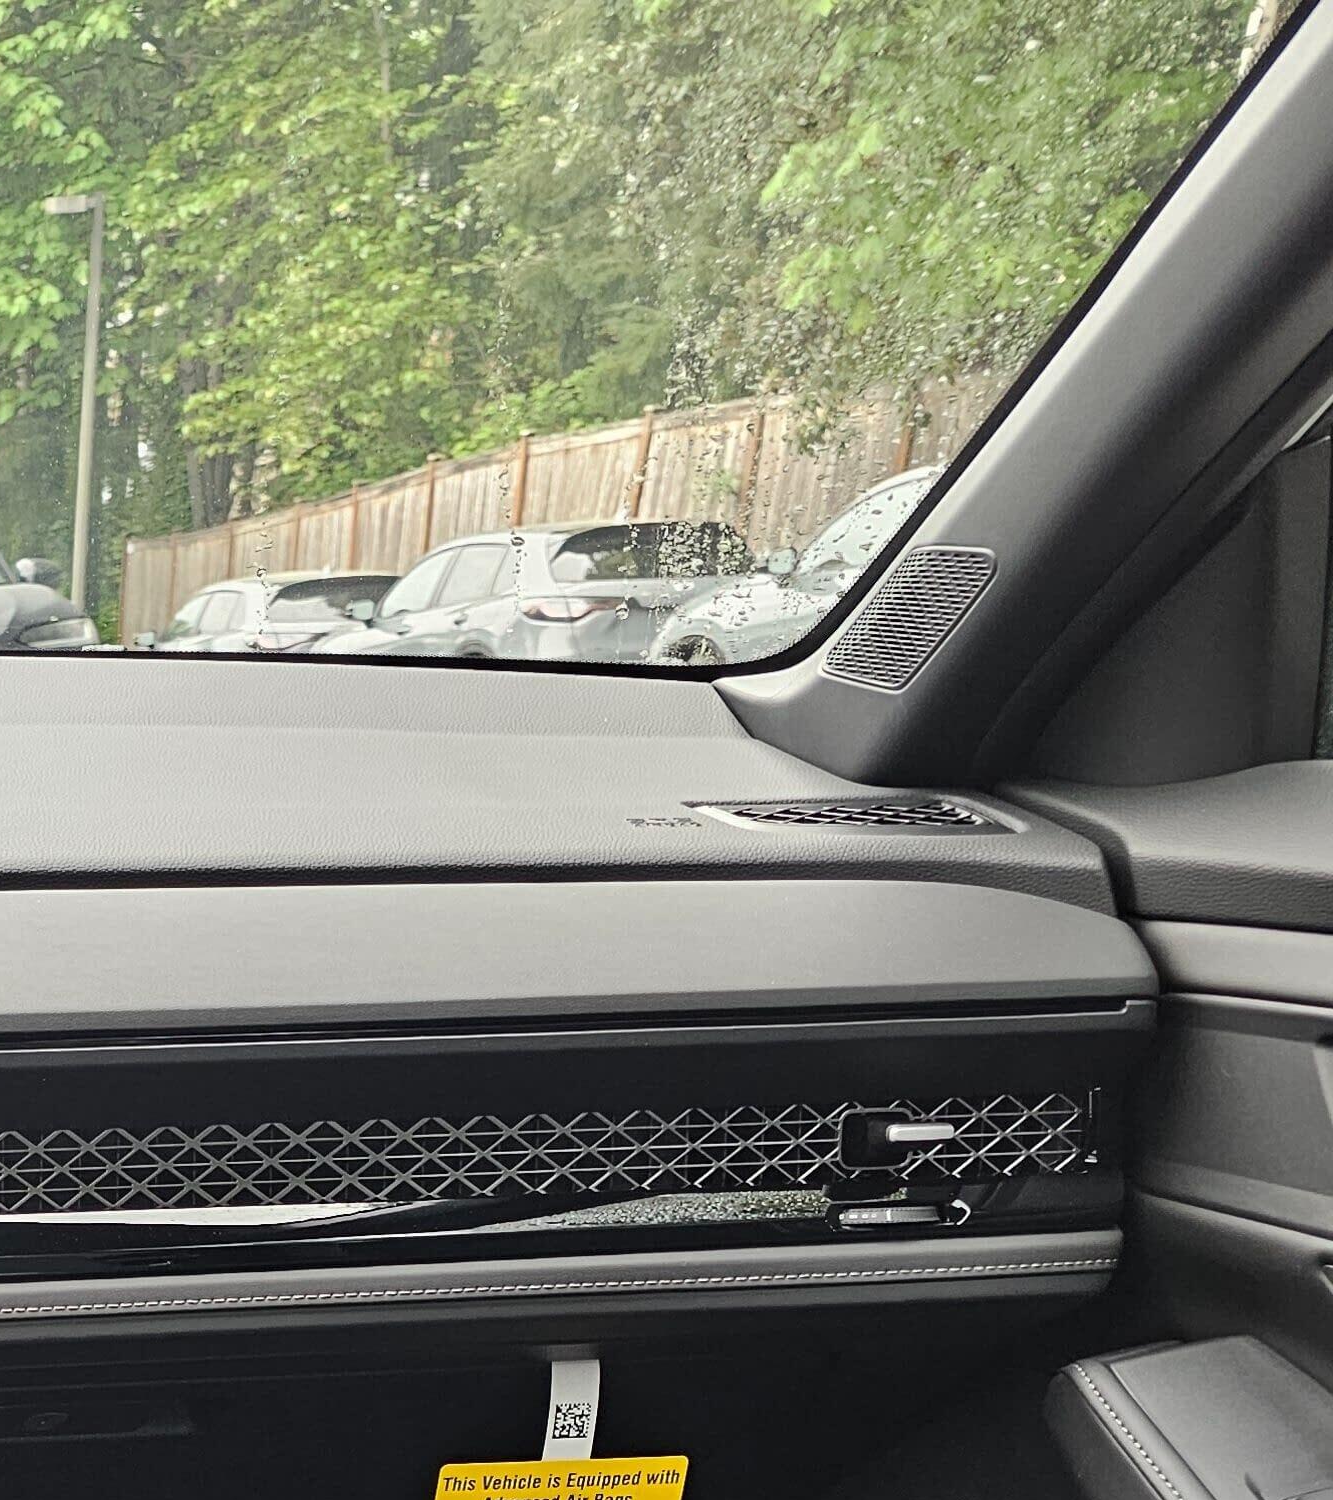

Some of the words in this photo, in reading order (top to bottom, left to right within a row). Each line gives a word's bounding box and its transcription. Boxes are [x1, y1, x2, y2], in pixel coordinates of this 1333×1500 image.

[443, 1477, 476, 1492] This
[482, 1474, 541, 1490] Vehicle
[547, 1473, 561, 1488] is
[566, 1470, 642, 1490] Equipped
[646, 1468, 680, 1484] with
